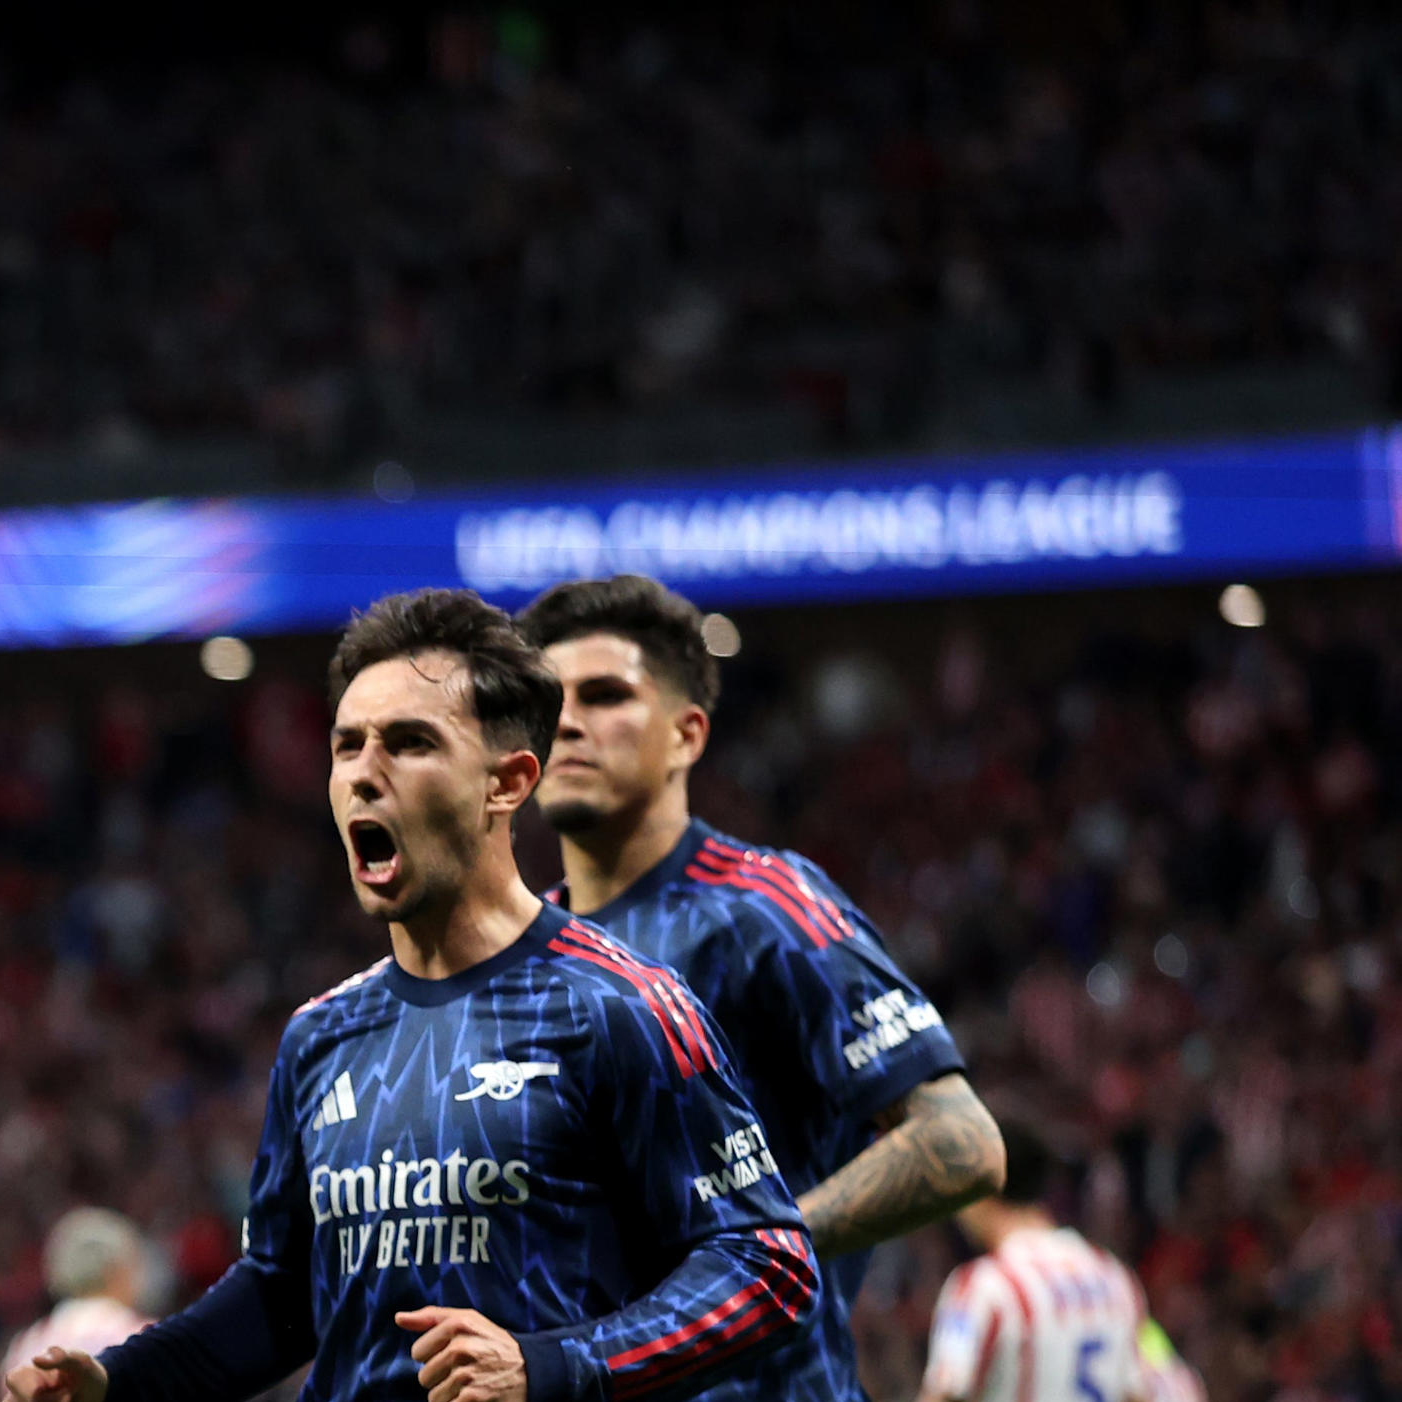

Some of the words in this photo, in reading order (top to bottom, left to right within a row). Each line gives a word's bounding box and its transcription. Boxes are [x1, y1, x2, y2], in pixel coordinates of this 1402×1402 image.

[710, 1122, 766, 1164] VISIT
[310, 1147, 530, 1226] Emirates
[694, 1148, 778, 1203] RWAN
[338, 1222, 372, 1276] FLY
[376, 1215, 490, 1270] BETTER
